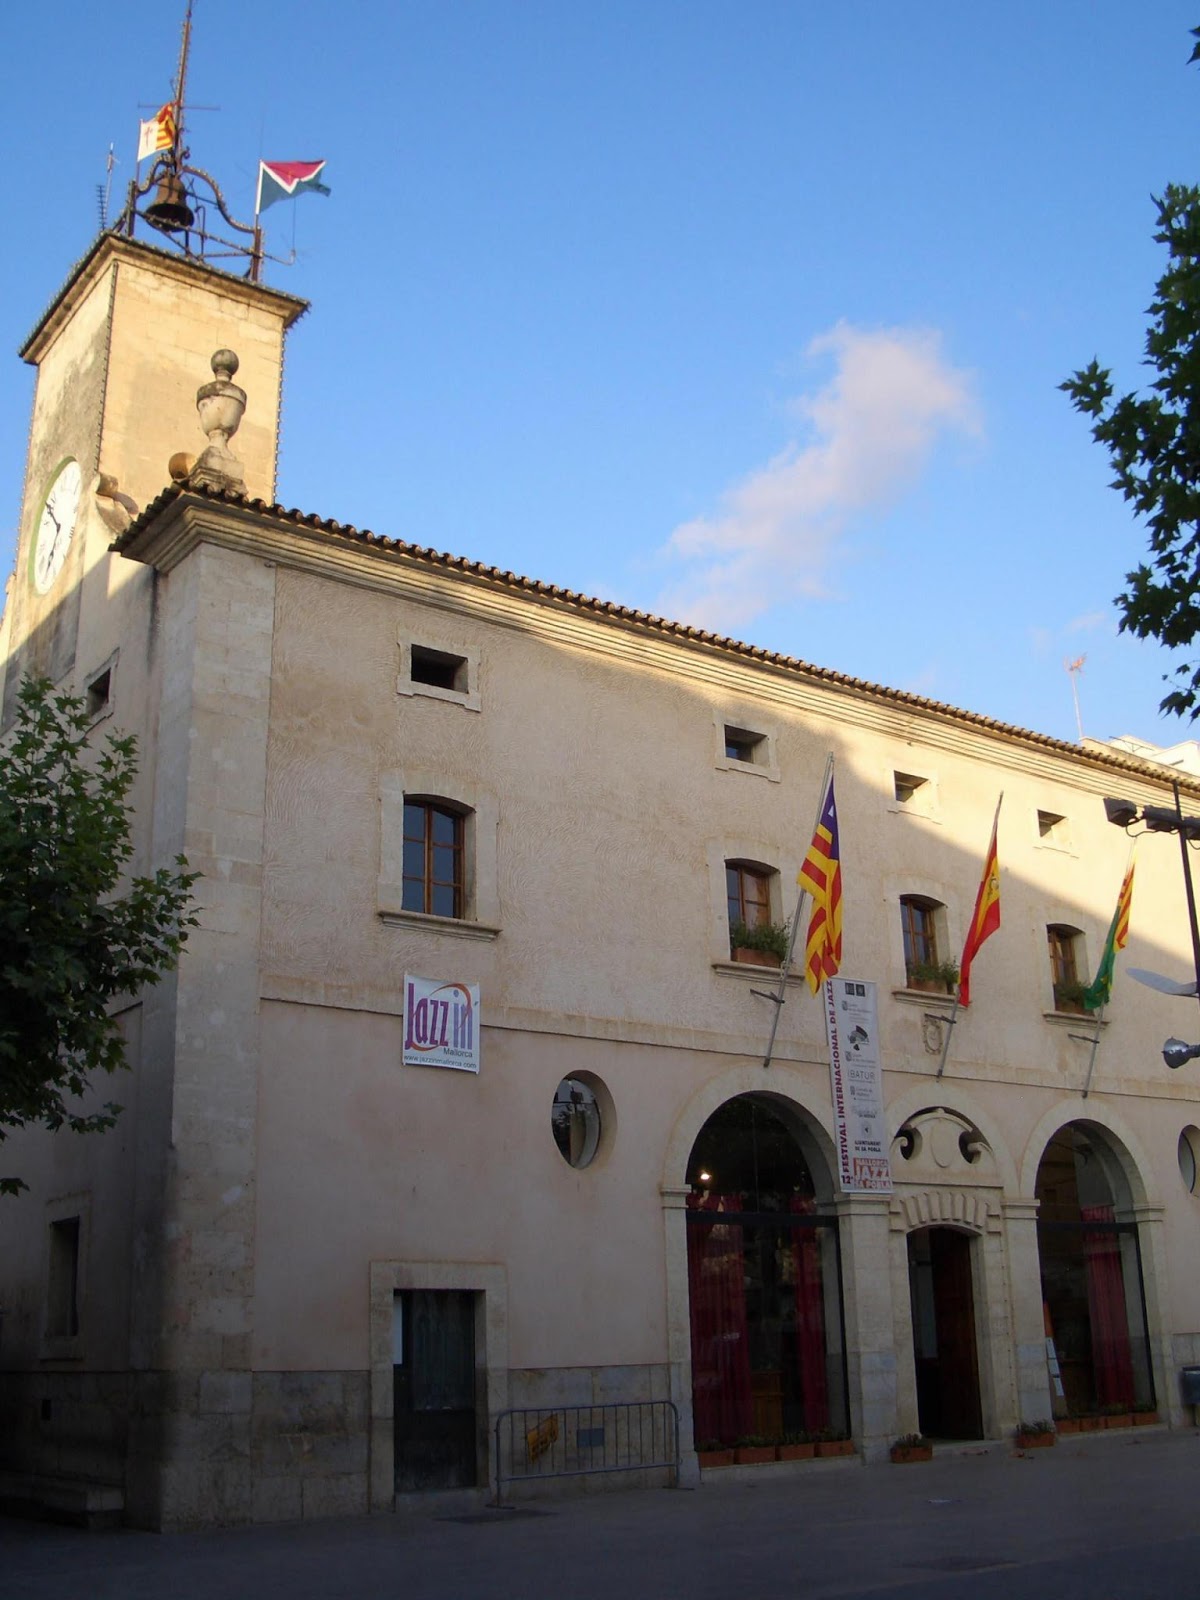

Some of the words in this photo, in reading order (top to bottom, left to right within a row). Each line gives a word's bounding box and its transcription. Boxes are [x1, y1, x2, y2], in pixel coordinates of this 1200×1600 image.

[826, 980, 834, 1007] JAZZ
[404, 983, 449, 1050] Jazz
[829, 1010, 836, 1024] DE
[443, 1048, 473, 1057] Mallorca
[831, 1028, 845, 1118] INTERNACIONAL
[839, 1122, 849, 1172] FESTIVAL
[855, 1165, 889, 1181] JAZZ
